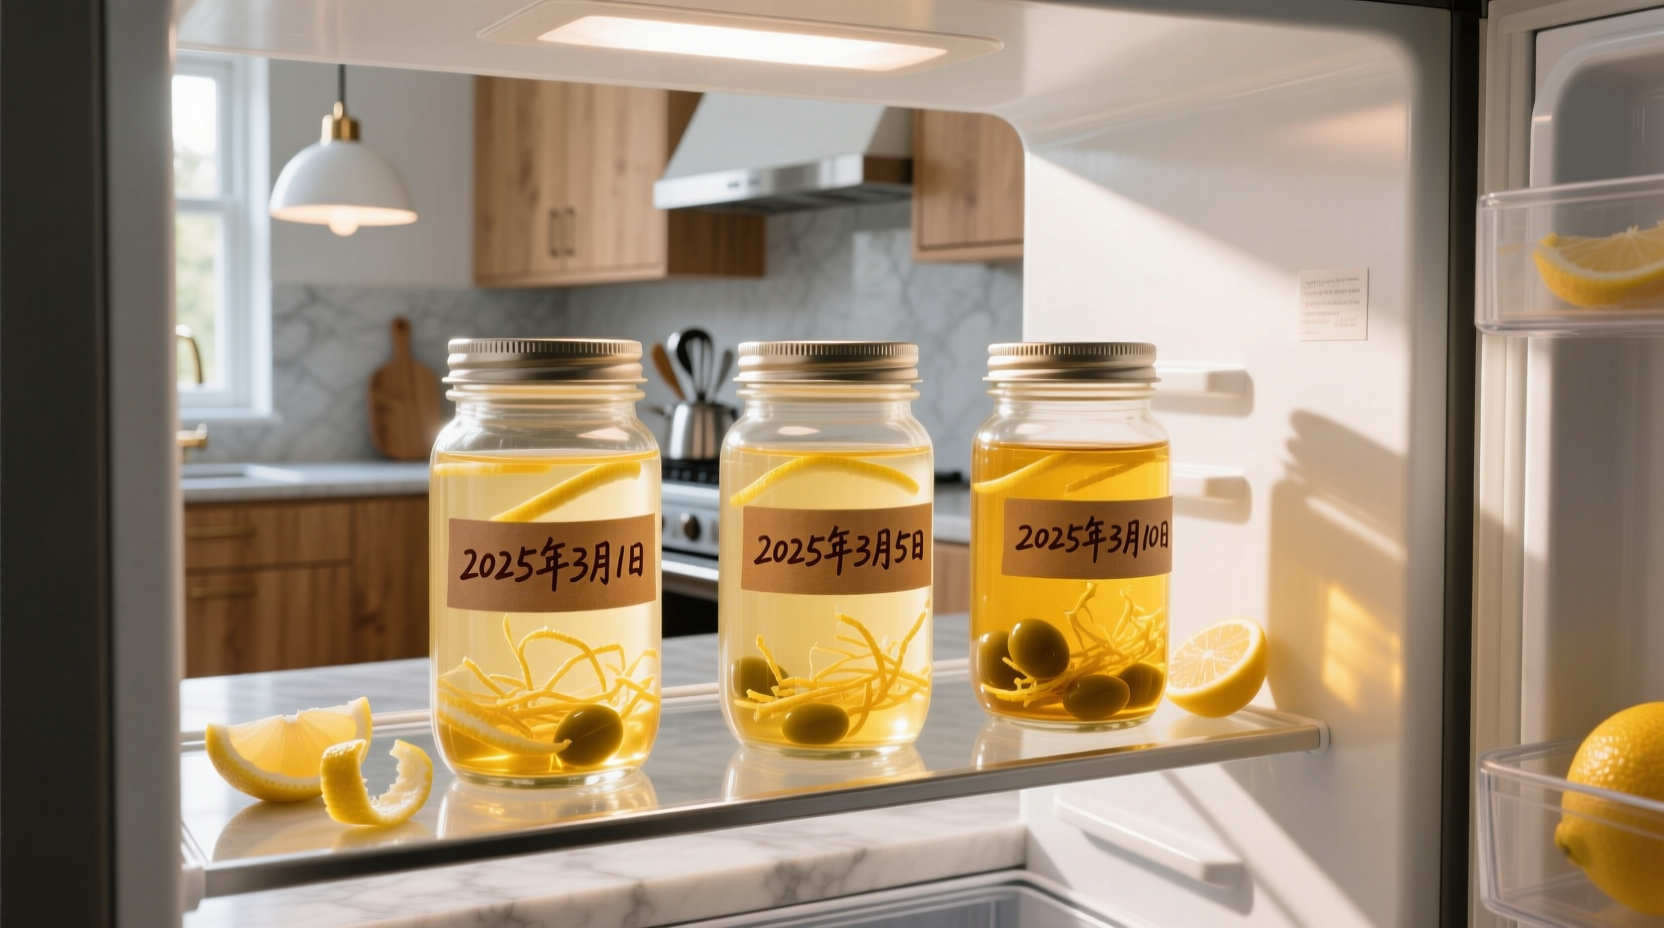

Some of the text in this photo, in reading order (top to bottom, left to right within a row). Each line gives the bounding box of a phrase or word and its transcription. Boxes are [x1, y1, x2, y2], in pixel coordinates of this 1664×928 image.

[459, 536, 644, 592] 2025年3月1日
[753, 524, 924, 577] 2025年3月5日
[1015, 515, 1169, 564] 2025年3月10日
